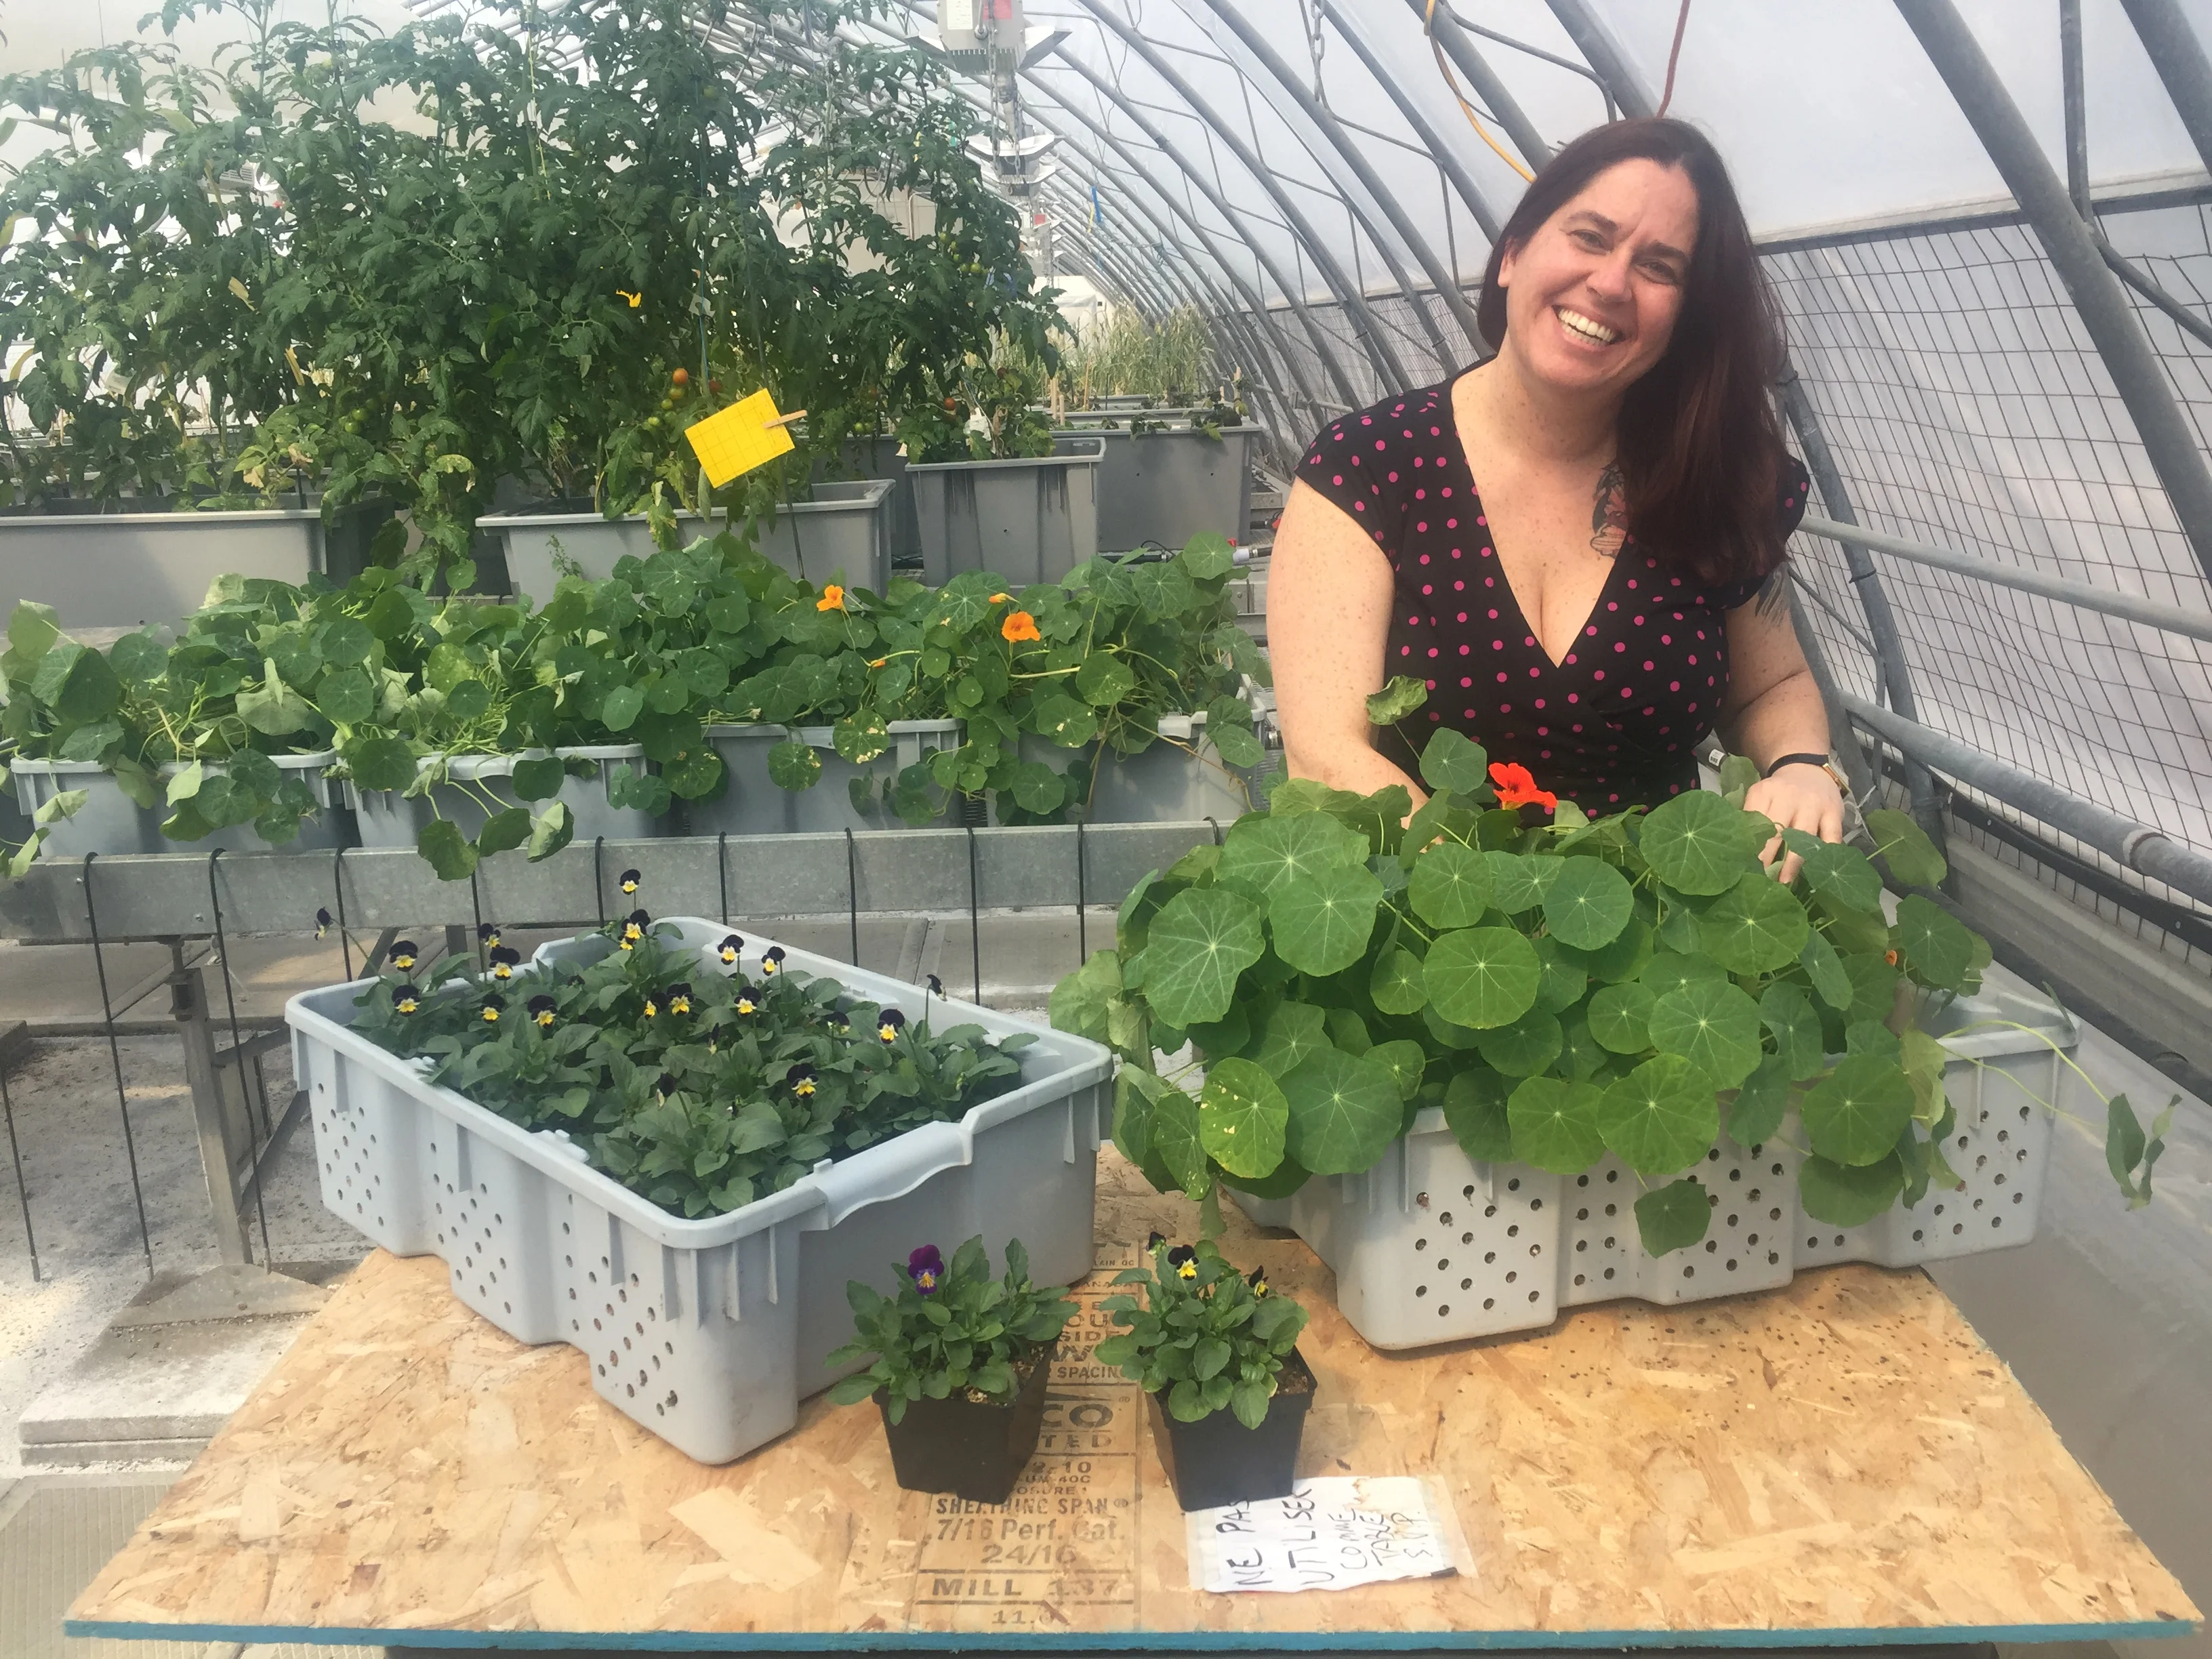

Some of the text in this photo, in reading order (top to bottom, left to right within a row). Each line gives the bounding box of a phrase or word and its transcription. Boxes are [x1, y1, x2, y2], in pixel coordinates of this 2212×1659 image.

[1000, 1519, 1063, 1541] Perf.
[1328, 1508, 1368, 1570] COMME
[1359, 1513, 1399, 1567] TABLE
[981, 1543, 1078, 1565] 24/16
[1226, 1547, 1273, 1585] NE
[932, 1578, 1022, 1596] MILL
